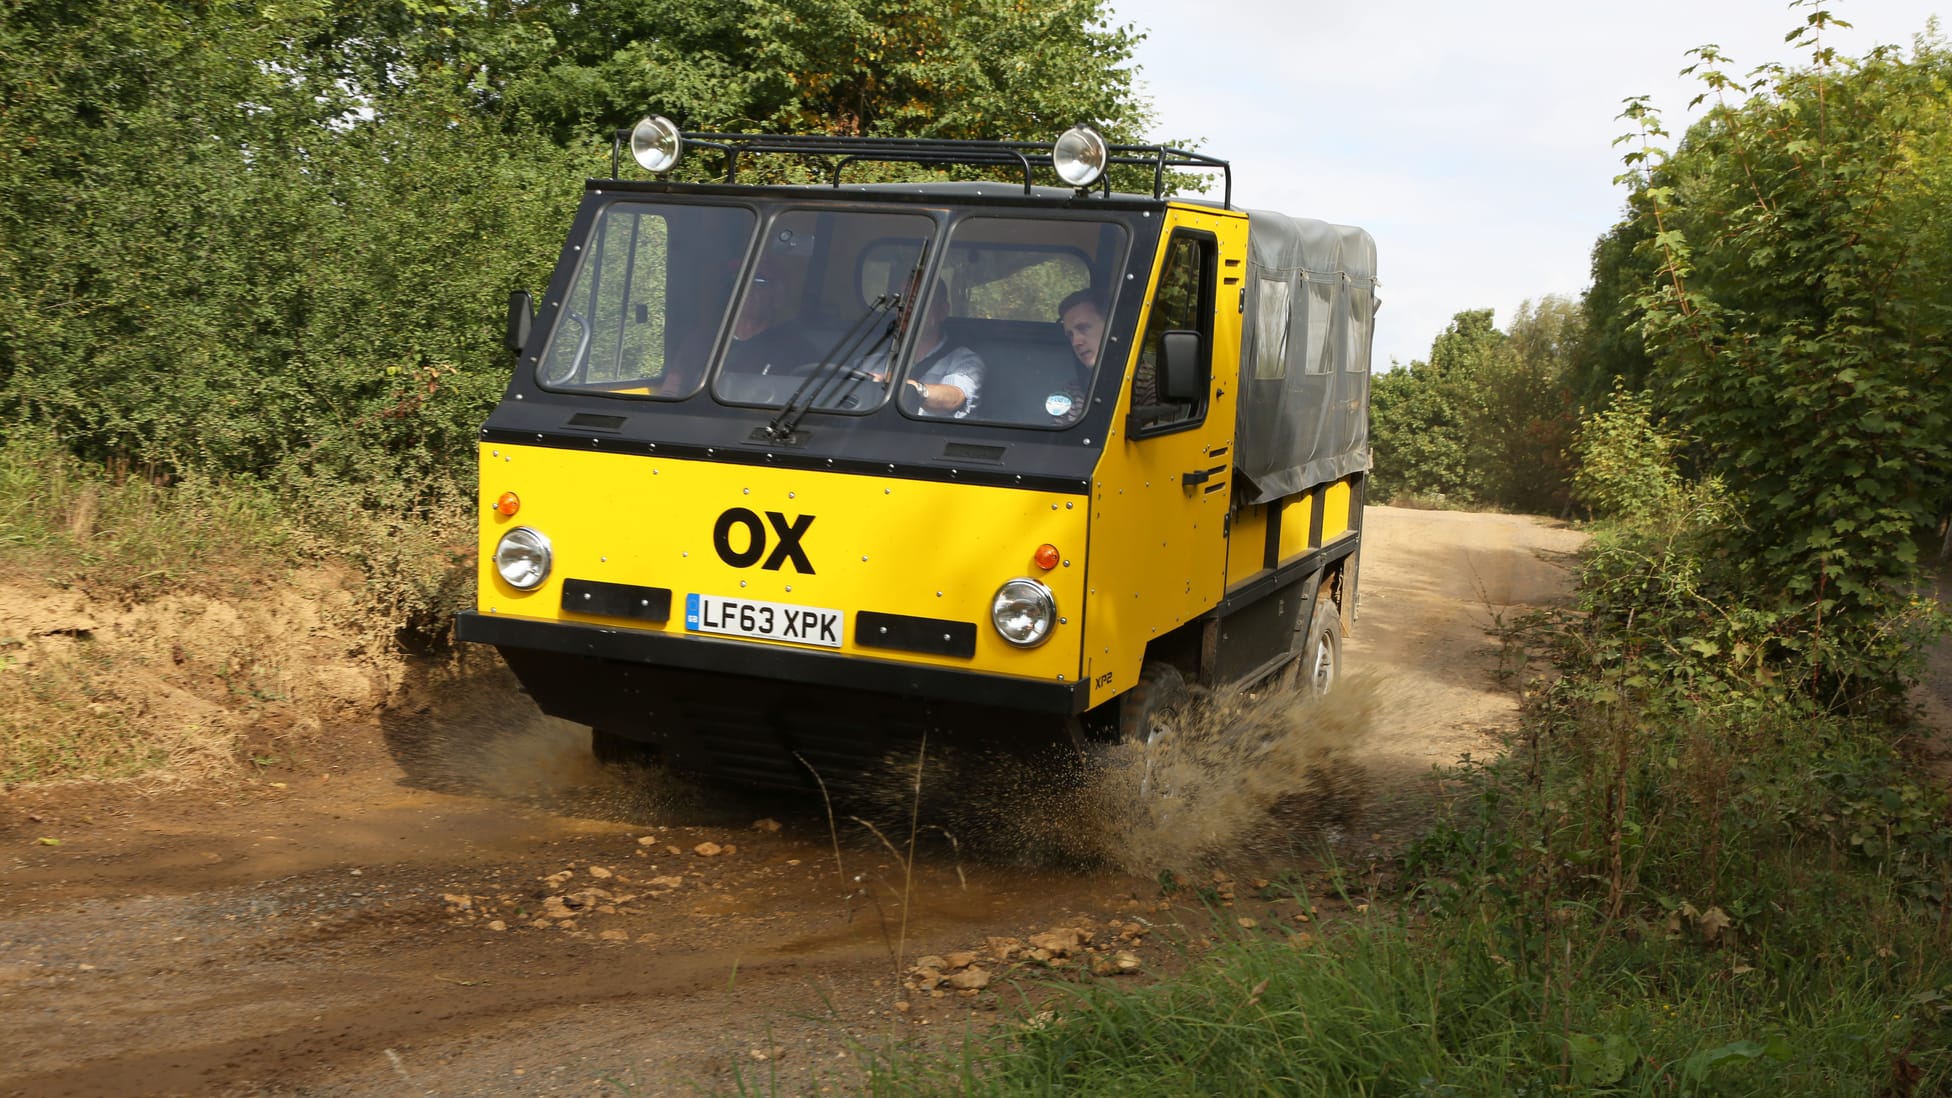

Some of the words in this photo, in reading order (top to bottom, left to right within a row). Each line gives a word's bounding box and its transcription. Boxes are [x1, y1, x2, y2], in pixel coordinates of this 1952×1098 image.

[713, 507, 816, 575] OX
[703, 600, 774, 634] LF63
[783, 609, 837, 642] XPK
[1095, 671, 1112, 690] XP2
